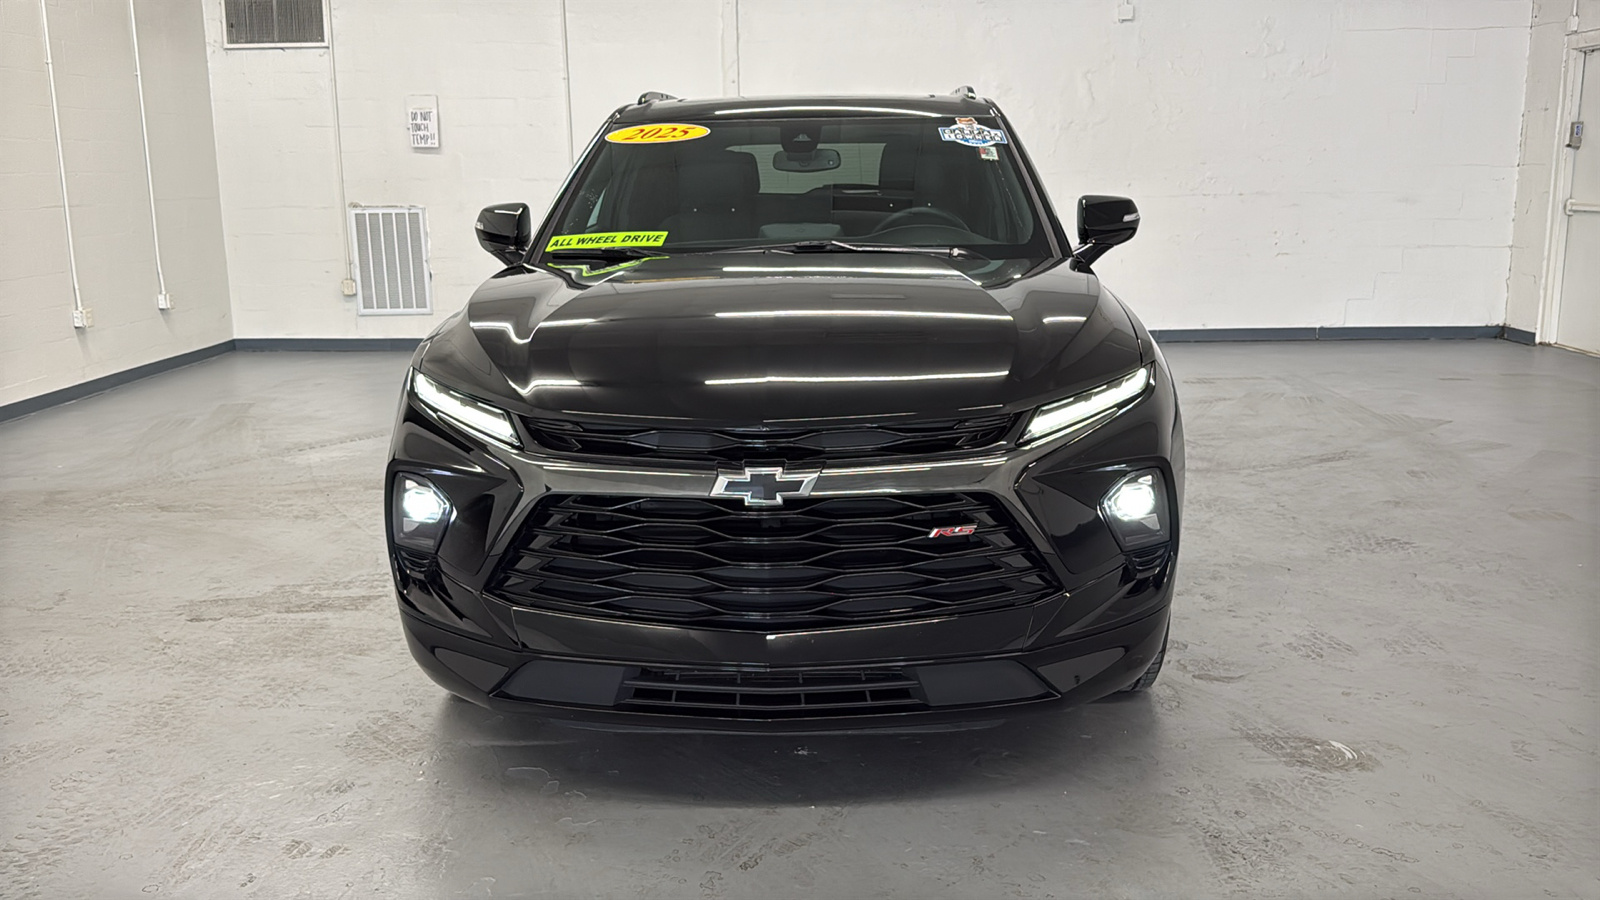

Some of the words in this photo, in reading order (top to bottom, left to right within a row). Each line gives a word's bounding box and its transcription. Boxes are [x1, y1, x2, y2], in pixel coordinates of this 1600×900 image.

[411, 111, 419, 122] DO
[420, 111, 433, 122] NOT
[410, 123, 429, 132] TOUCH
[622, 127, 696, 140] 2025
[550, 239, 573, 247] ALL
[576, 235, 617, 245] WHEEL
[621, 234, 664, 243] DRIVE
[928, 523, 977, 538] RS
